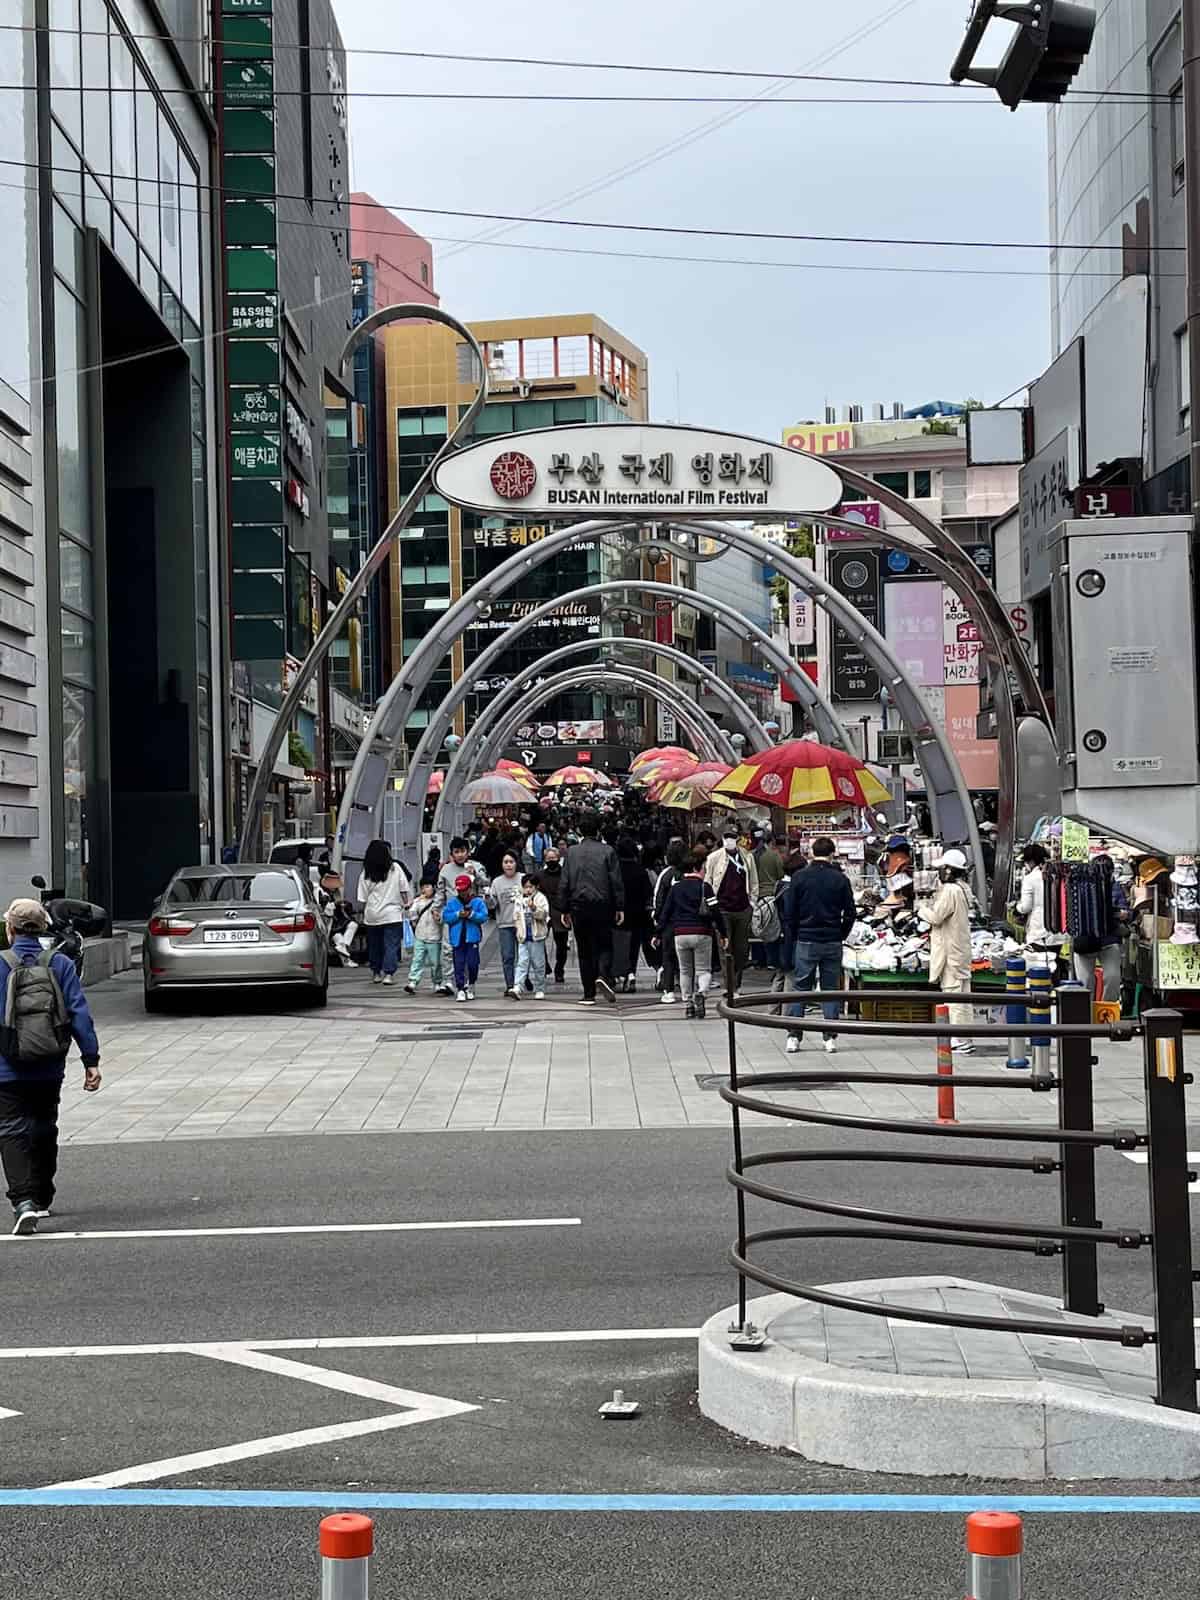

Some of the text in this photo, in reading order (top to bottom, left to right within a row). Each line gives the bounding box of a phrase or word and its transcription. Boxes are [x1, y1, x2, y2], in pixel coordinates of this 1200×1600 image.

[234, 446, 278, 469] 애플치과
[548, 452, 774, 485] 부산 국제 영화제
[547, 489, 769, 505] BUSAN International Film Festival
[960, 627, 977, 638] 2F
